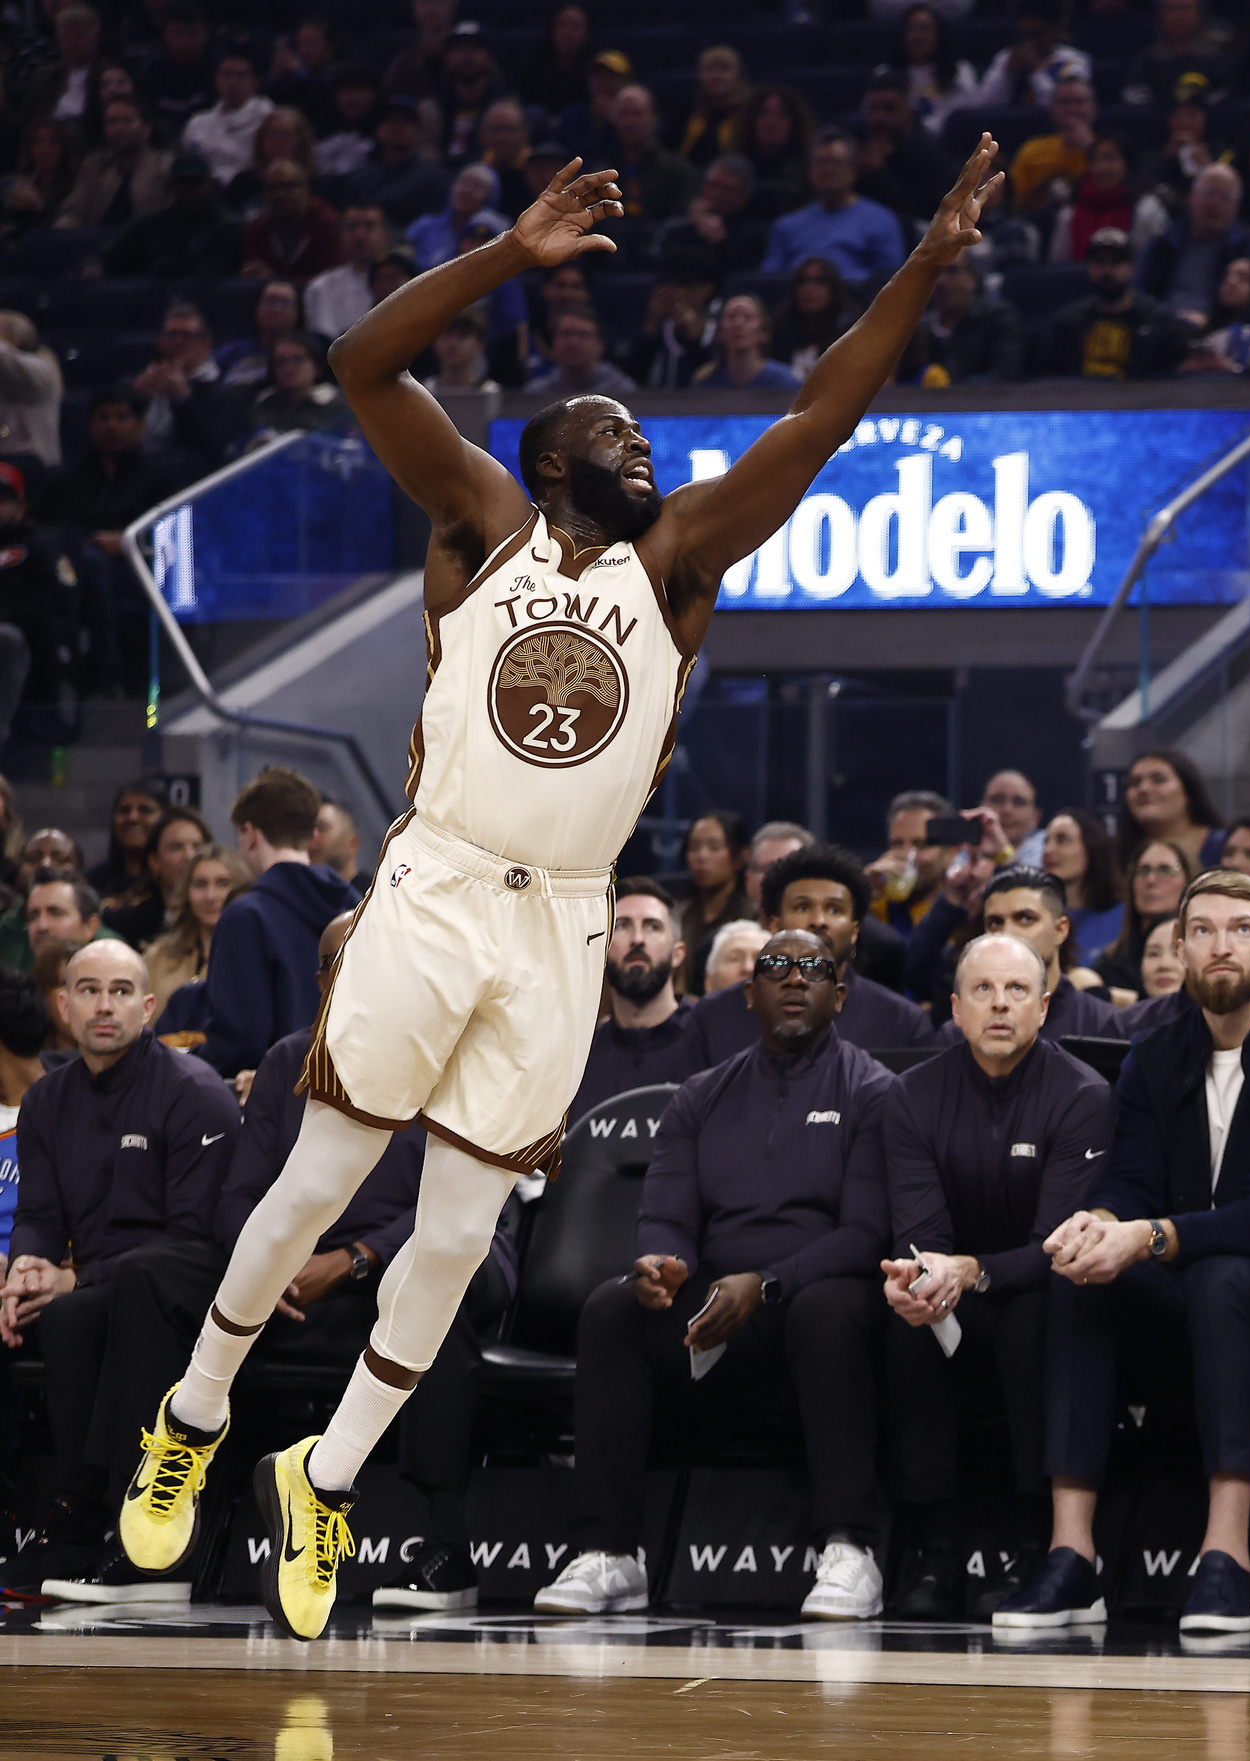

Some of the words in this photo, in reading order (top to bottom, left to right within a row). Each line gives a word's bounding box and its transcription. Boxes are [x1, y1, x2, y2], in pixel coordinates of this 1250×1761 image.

[828, 418, 964, 462] RVEZA
[510, 575, 536, 592] The
[494, 593, 638, 647] TOWN
[522, 703, 581, 752] 23
